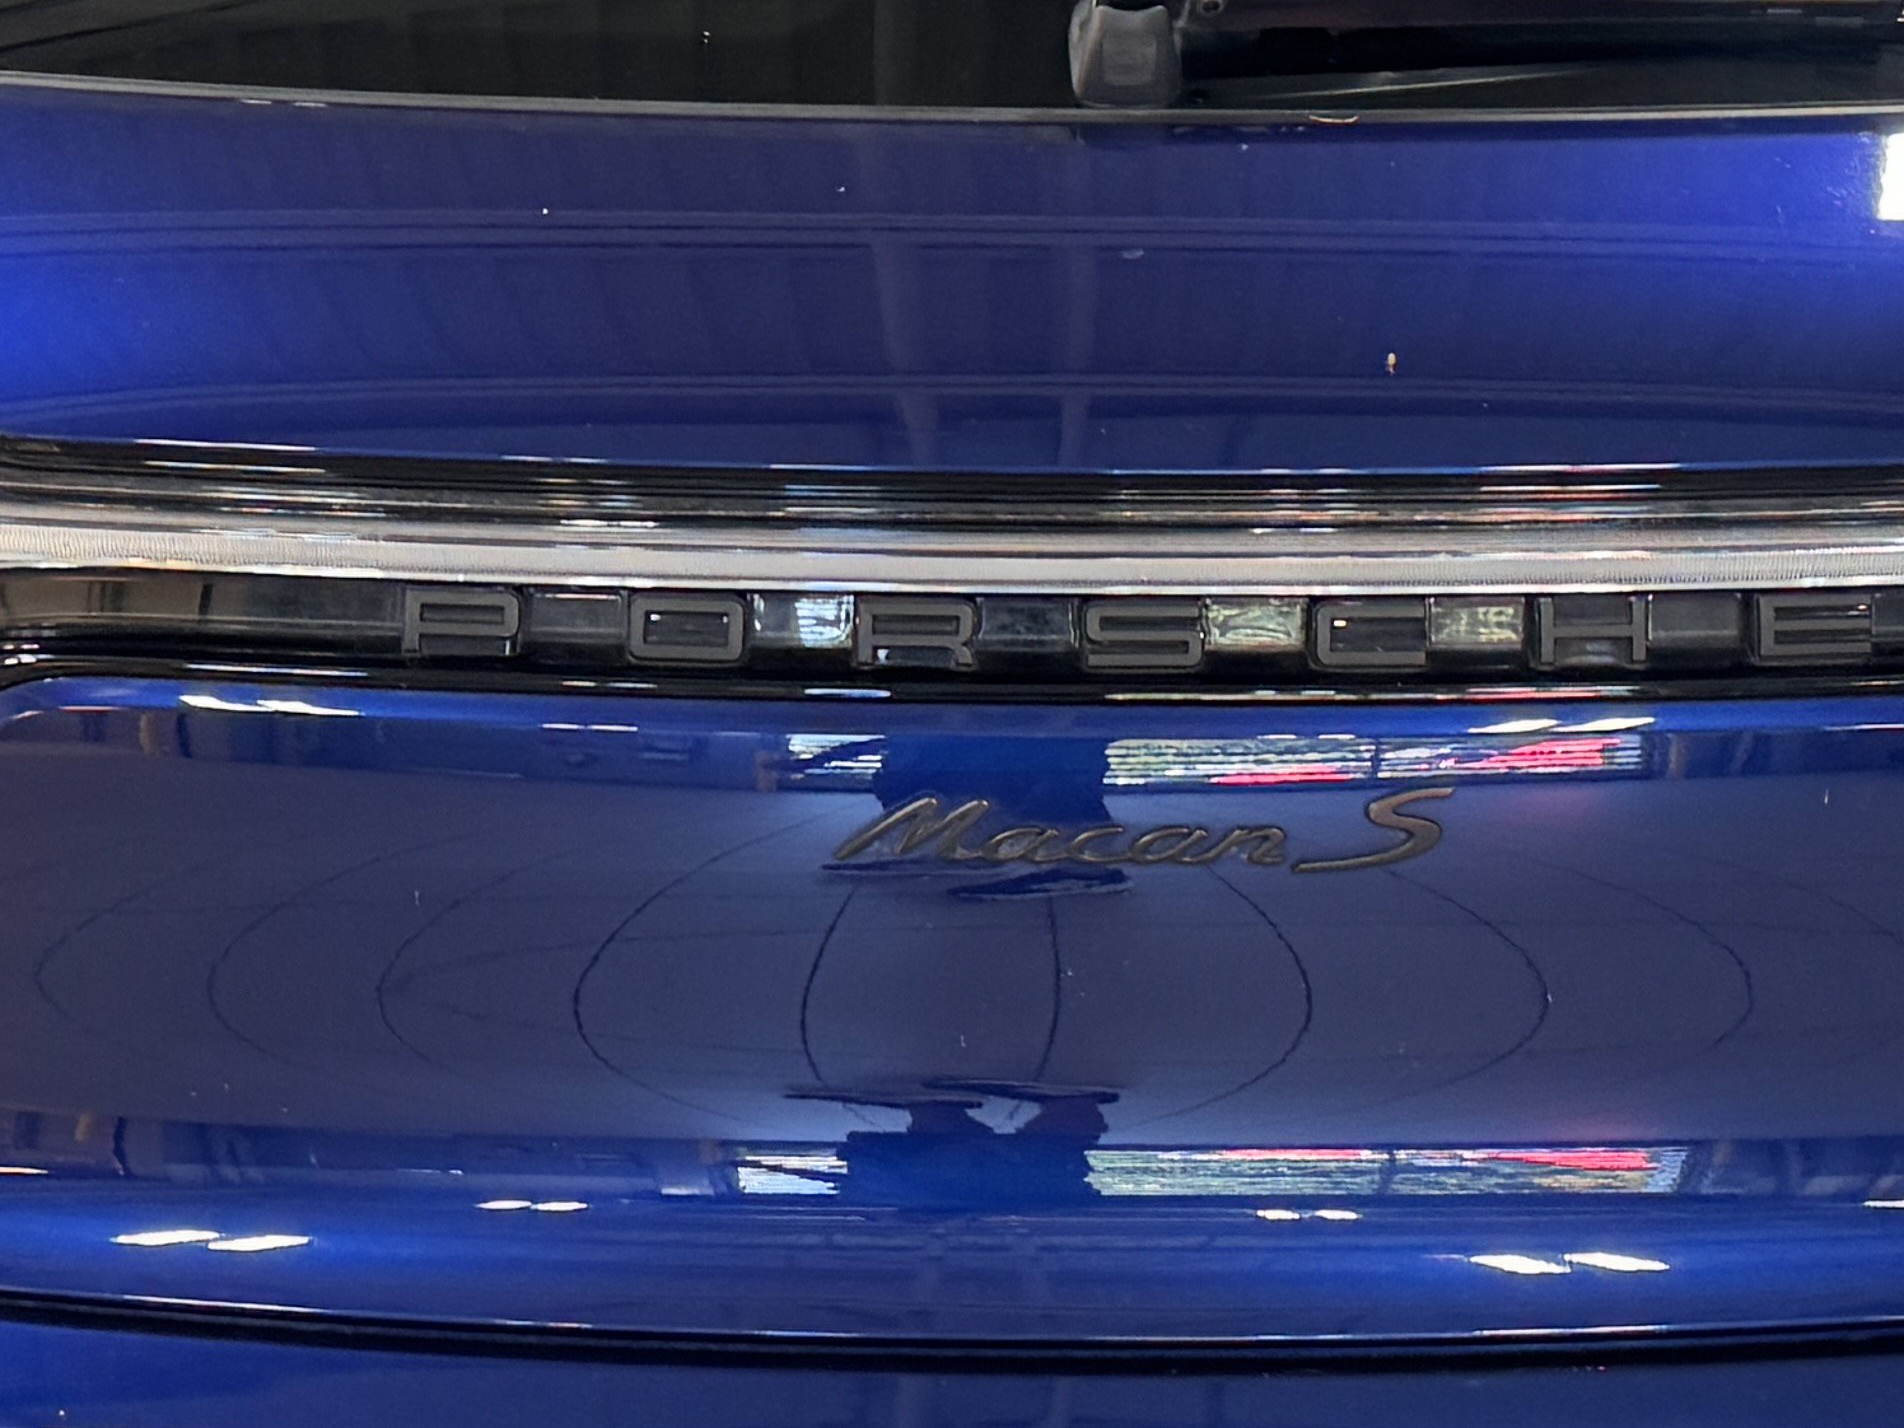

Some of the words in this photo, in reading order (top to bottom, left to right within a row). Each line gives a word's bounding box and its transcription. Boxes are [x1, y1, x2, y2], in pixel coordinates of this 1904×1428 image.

[404, 586, 1873, 669] PORSCHE
[834, 796, 1287, 864] Macan
[1291, 786, 1456, 873] S
